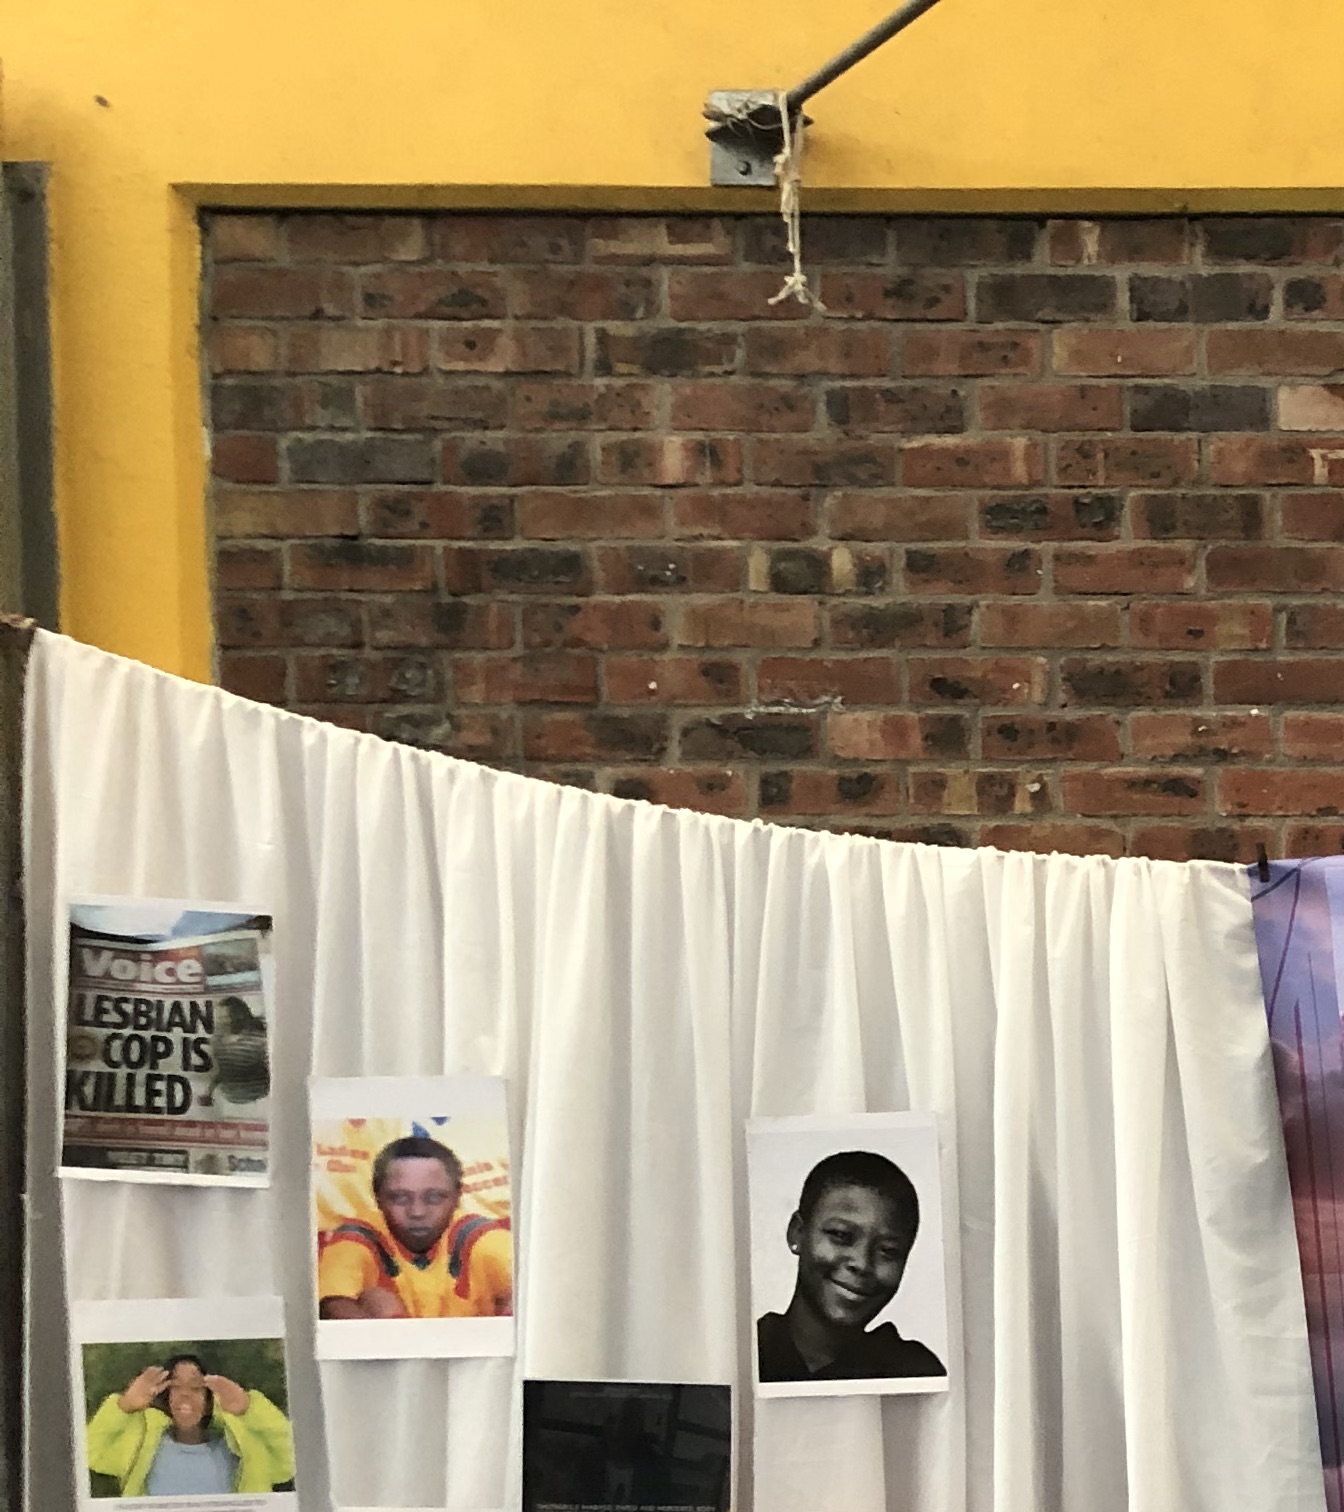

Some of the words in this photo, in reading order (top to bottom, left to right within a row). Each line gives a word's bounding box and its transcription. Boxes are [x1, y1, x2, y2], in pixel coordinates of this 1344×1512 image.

[82, 949, 203, 984] Voice
[74, 993, 215, 1034] LESBIAN
[102, 1032, 174, 1071] COP
[181, 1036, 214, 1073] IS
[65, 1070, 192, 1116] KILLED
